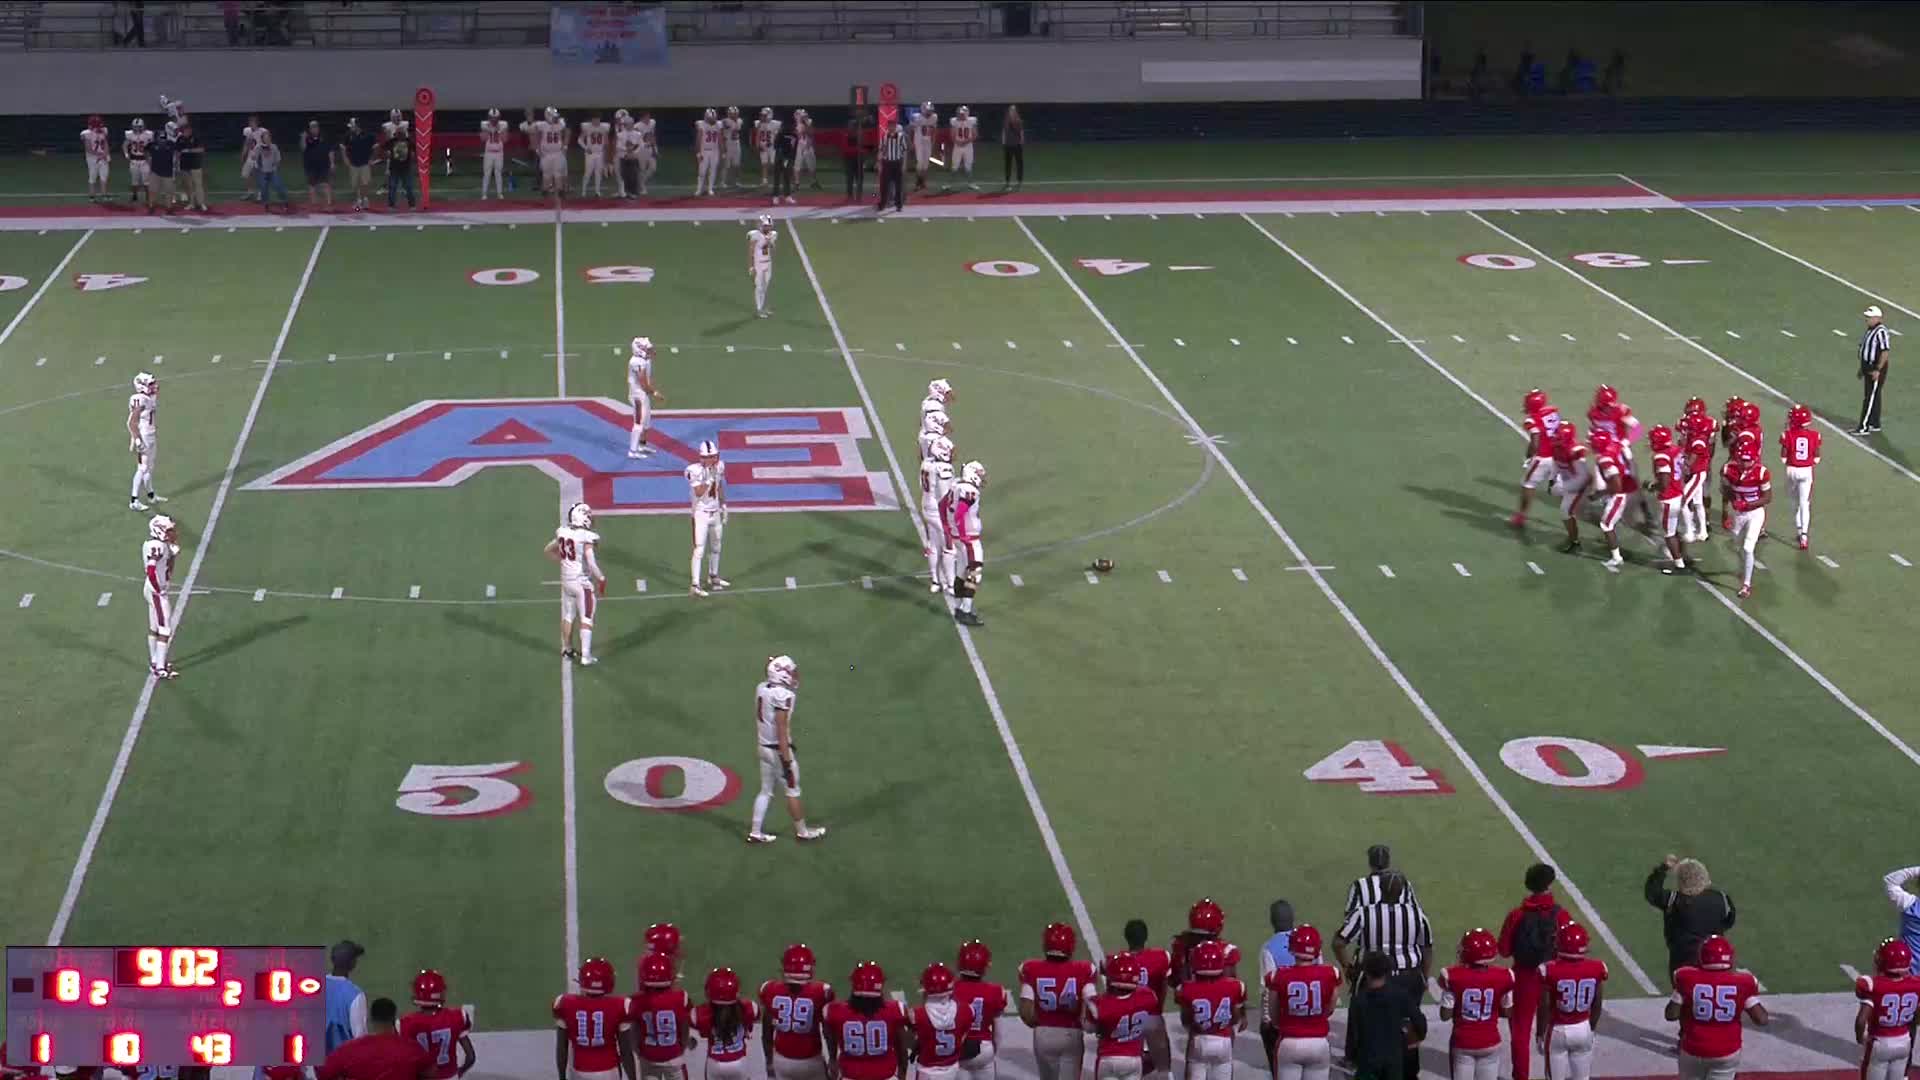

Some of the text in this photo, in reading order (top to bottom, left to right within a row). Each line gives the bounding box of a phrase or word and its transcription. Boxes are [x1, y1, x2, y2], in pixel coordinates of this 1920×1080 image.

[1796, 437, 1808, 460] 9
[558, 536, 577, 561] 33
[1036, 977, 1078, 1011] 54
[1287, 980, 1323, 1016] 21
[1461, 988, 1495, 1021] 61
[1556, 978, 1597, 1013] 30
[1692, 984, 1737, 1022] 65
[1878, 992, 1919, 1027] 32
[575, 1009, 606, 1047] 11
[642, 1009, 678, 1047] 19
[772, 995, 814, 1033] 39
[1191, 996, 1233, 1029] 24
[843, 1020, 888, 1056] 60
